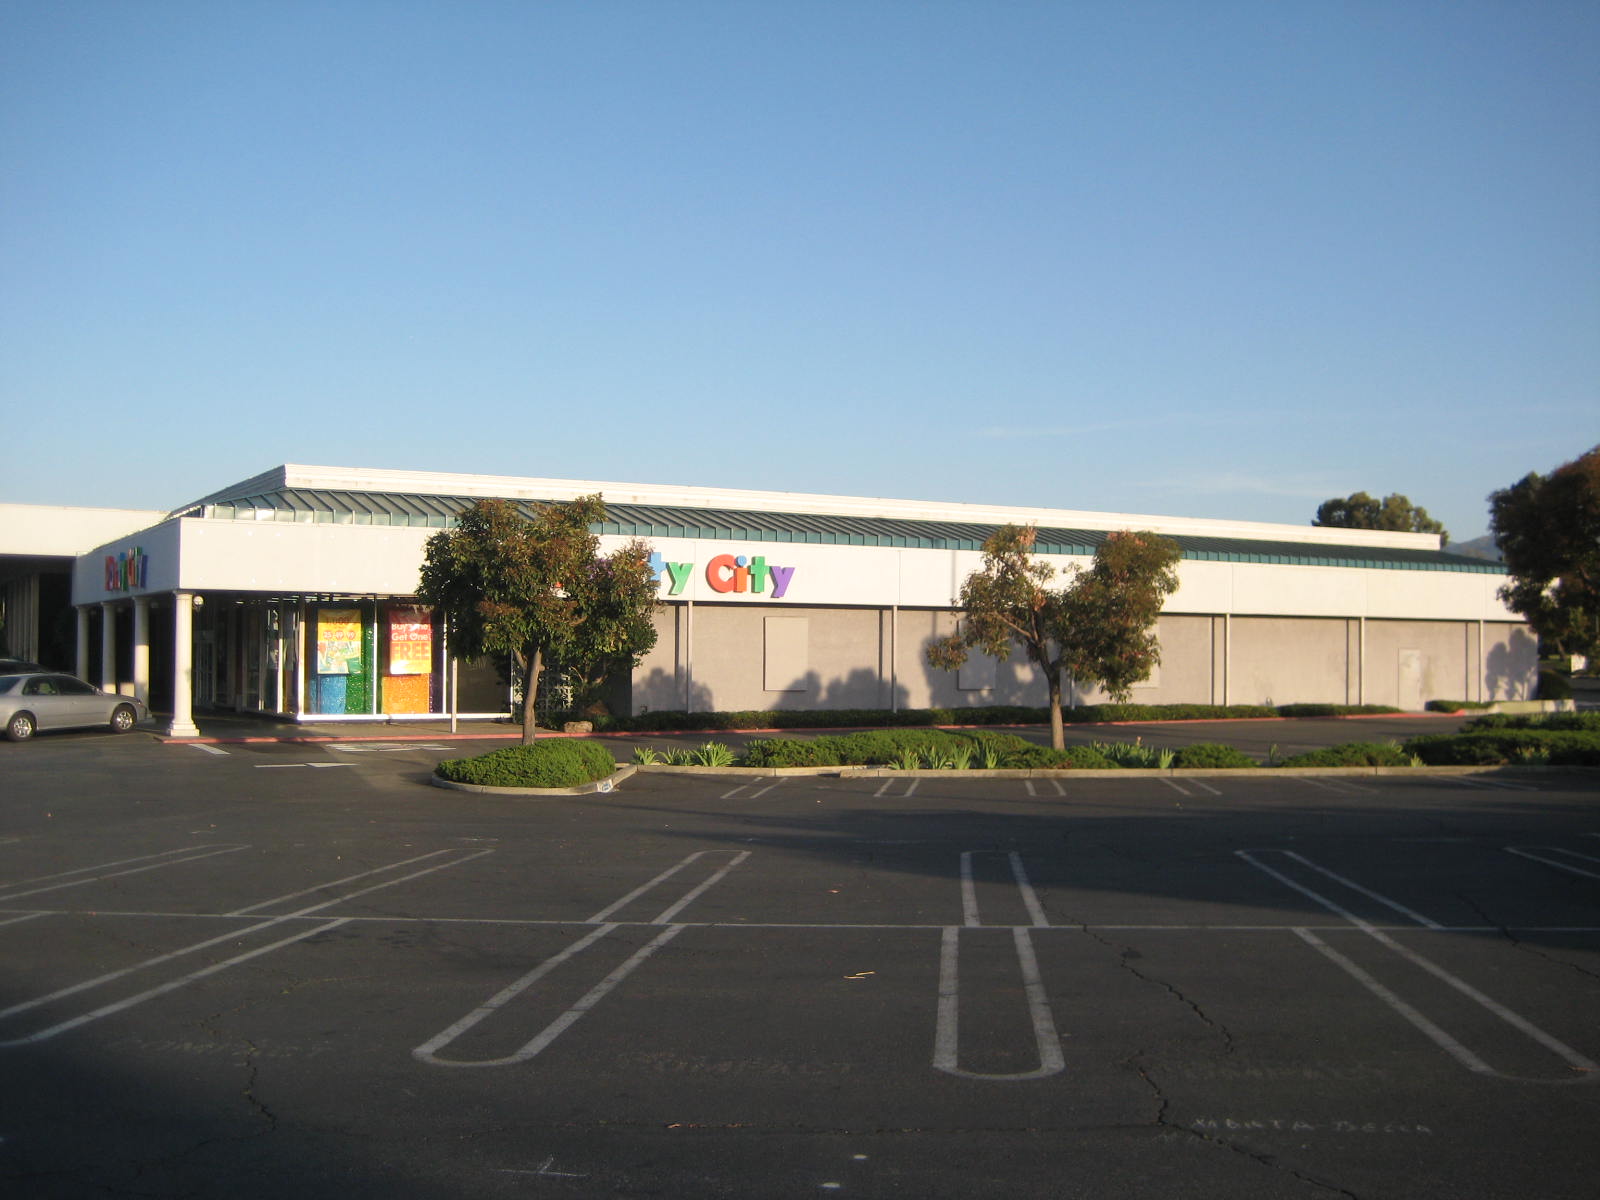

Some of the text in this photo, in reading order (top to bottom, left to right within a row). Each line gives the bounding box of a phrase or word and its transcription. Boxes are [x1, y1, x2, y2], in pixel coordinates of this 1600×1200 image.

[706, 554, 796, 598] City
[391, 632, 408, 641] Get
[391, 642, 430, 660] FREE
